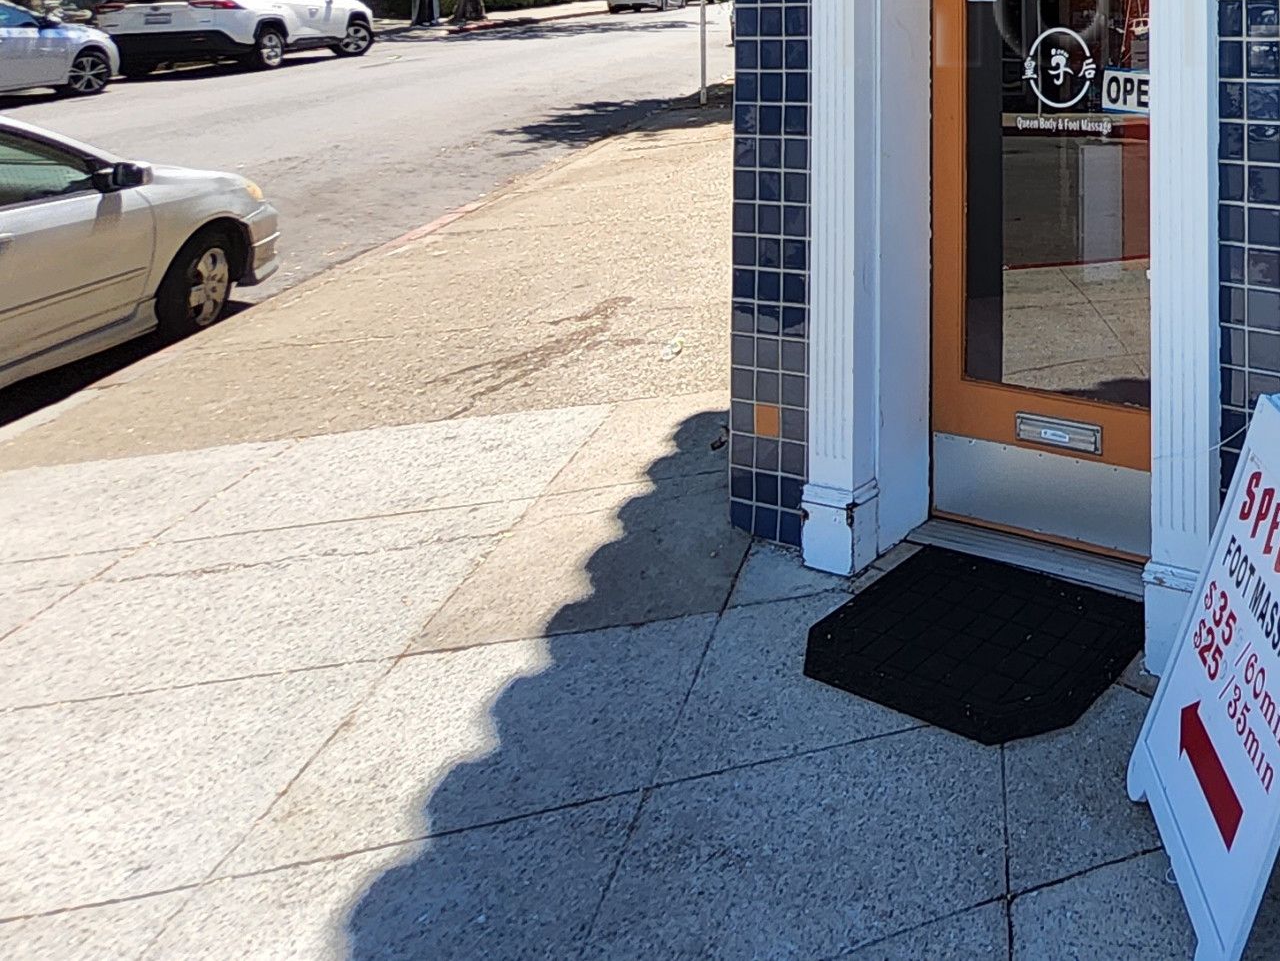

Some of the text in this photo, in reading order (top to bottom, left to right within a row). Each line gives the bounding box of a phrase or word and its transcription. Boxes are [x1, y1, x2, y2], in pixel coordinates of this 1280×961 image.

[1106, 75, 1150, 108] OPE
[1016, 116, 1112, 135] Queen Body & Foot Massage
[1222, 535, 1256, 598] FOOT
[1204, 580, 1237, 646] $35
[1193, 618, 1224, 681] $25
